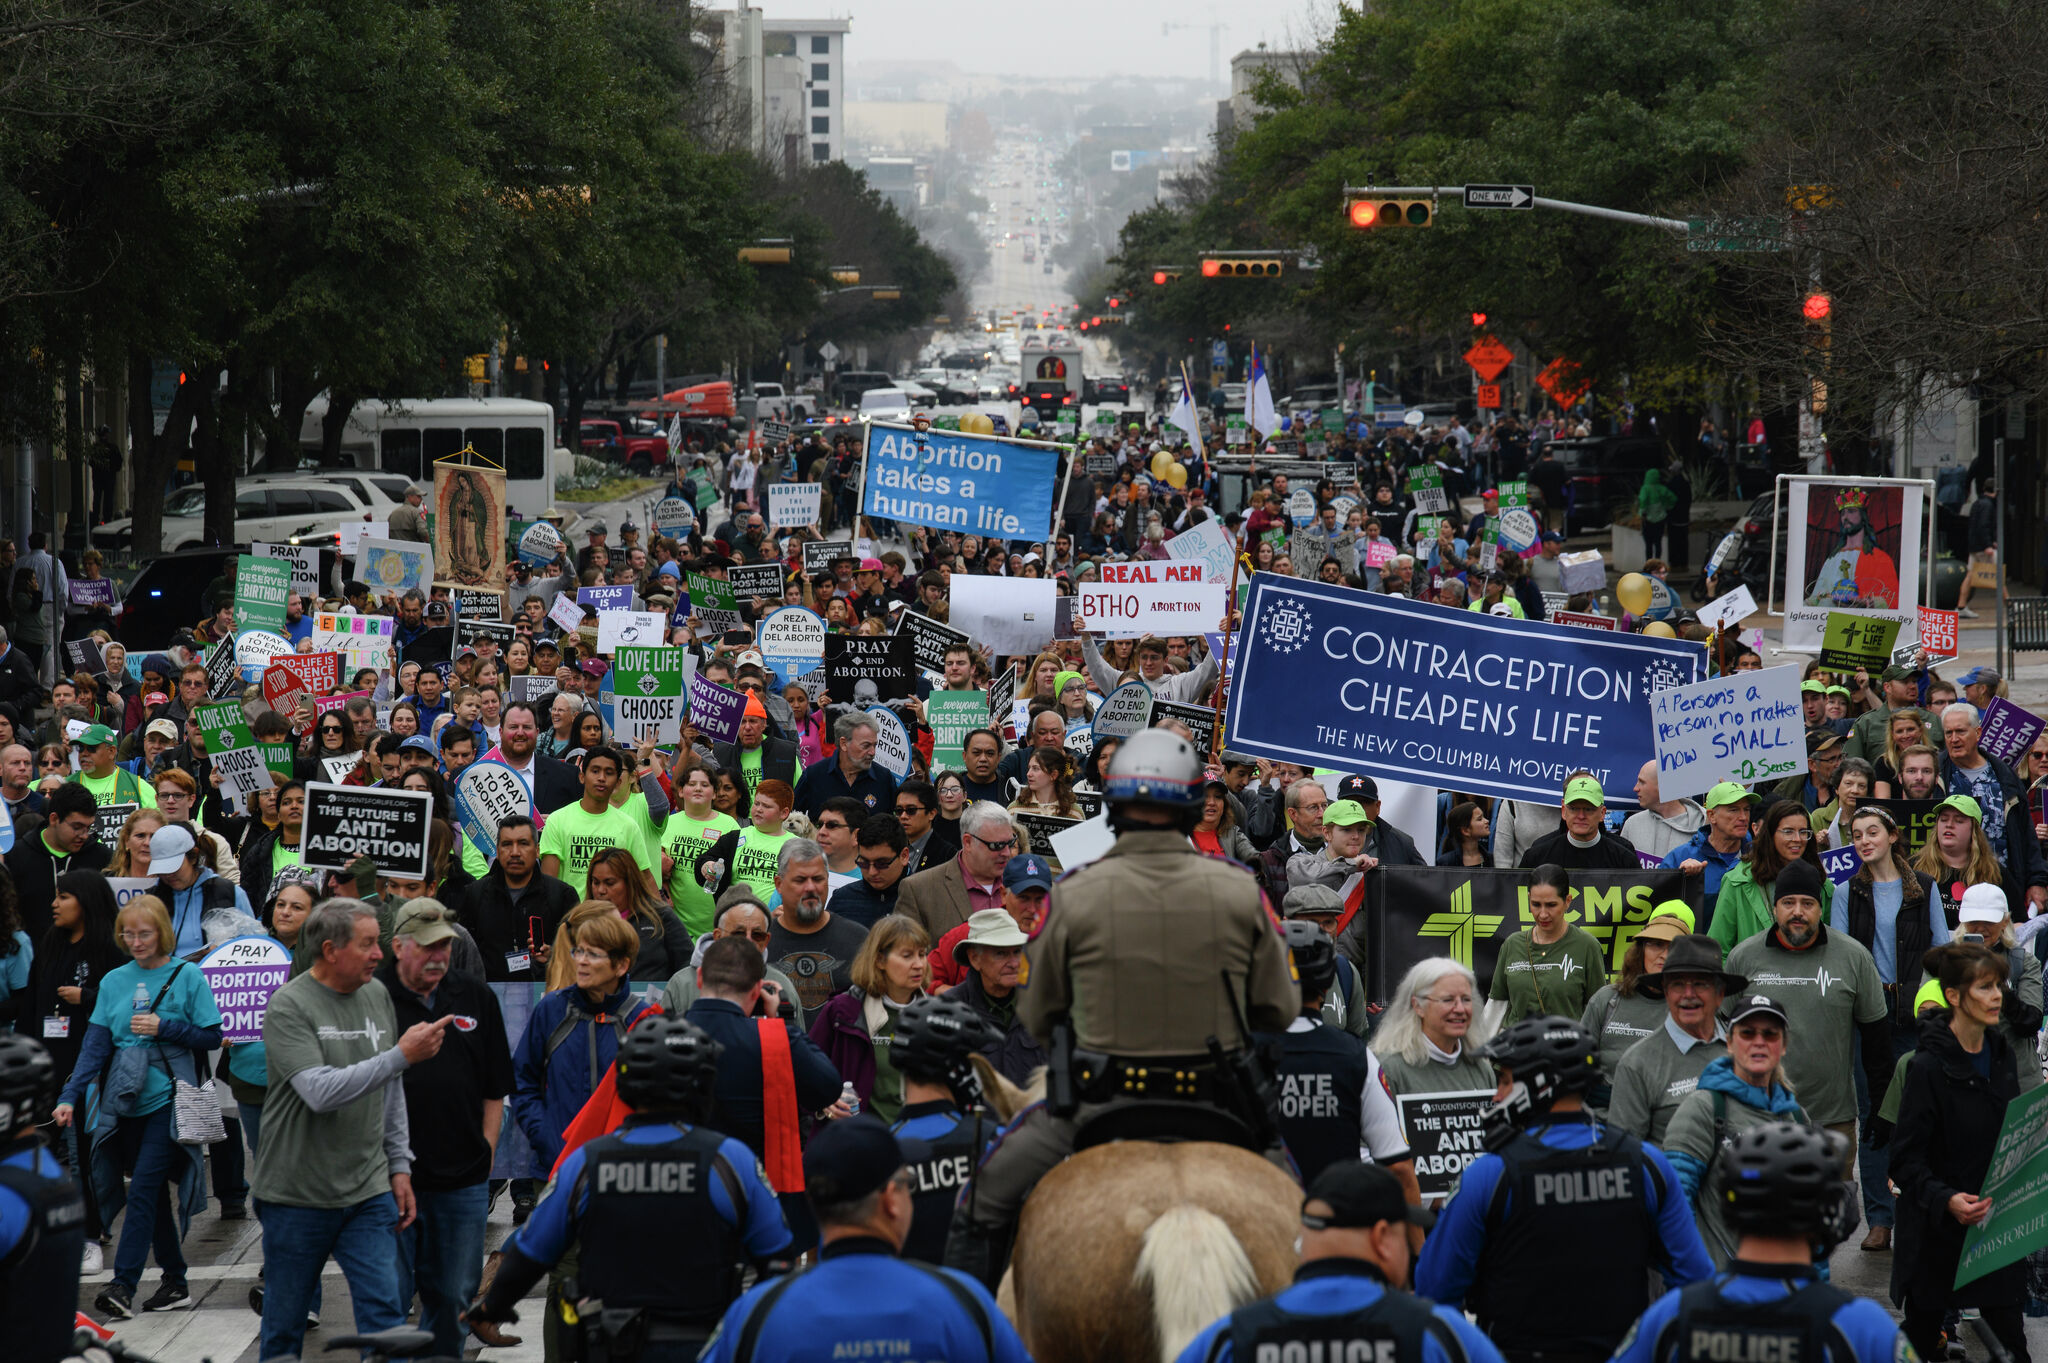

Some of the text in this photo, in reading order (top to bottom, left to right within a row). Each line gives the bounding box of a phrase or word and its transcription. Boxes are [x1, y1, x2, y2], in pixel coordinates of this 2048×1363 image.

[1471, 190, 1513, 202] ONE WAY
[1482, 388, 1496, 399] 15
[879, 435, 1002, 473] Abortion
[1409, 464, 1439, 479] LOVE LIFE
[876, 464, 975, 498] takes a
[771, 486, 819, 495] ADOPTION
[1417, 489, 1442, 500] CHOOSE
[873, 490, 1025, 534] human life.
[1427, 501, 1439, 512] LIFE
[658, 512, 690, 520] ABORTION
[538, 524, 554, 534] PRAY
[543, 534, 557, 543] END
[270, 546, 302, 557] PRAY
[240, 572, 288, 587] DESERVES
[1103, 566, 1202, 583] REAL MEN
[688, 573, 732, 597] LOVE LIFE
[731, 578, 779, 588] POST-ROE
[76, 594, 109, 602] WOMEN
[243, 584, 287, 604] BIRTHDAY
[589, 588, 622, 599] TEXAS
[733, 587, 779, 596] GENERATION
[459, 596, 498, 606] OST-ROE
[600, 598, 609, 607] IS
[1083, 594, 1139, 618] BTHO
[1150, 602, 1201, 612] ABORTION
[696, 607, 735, 622] CHOOSE
[1790, 612, 1818, 622] Iglesia
[1946, 614, 1955, 624] IS
[323, 616, 392, 635] EVERY
[711, 621, 730, 634] LIFE
[770, 624, 788, 632] POR
[1865, 626, 1885, 635] LCMS
[1921, 622, 1954, 635] DENCE
[257, 633, 283, 645] PRAY
[784, 633, 823, 643] ABORTO
[906, 621, 952, 646] THE FUTURE
[1863, 633, 1884, 645] LIFE
[248, 638, 286, 653] TO END
[845, 641, 892, 654] PRAY
[1922, 635, 1954, 650] SED
[322, 655, 333, 665] IS
[618, 650, 680, 672] LOVE LIFE
[1323, 626, 1633, 703] CONTRACEPTION
[210, 661, 237, 698] ABORTIO
[833, 667, 906, 678] ABORTION.
[267, 670, 289, 693] STOP
[1121, 689, 1143, 699] PRAY
[1657, 698, 1667, 714] A
[1746, 686, 1761, 701] a
[622, 699, 674, 720] CHOOSE
[942, 700, 979, 713] everyone
[1114, 700, 1145, 710] TO END
[1720, 712, 1744, 725] no
[1752, 700, 1800, 722] matter
[196, 704, 244, 731] LOVE LIFE
[1101, 712, 1147, 721] ABORTION
[1340, 678, 1602, 748] CHEAPENS LIFE
[875, 712, 897, 731] PRAY
[882, 729, 901, 745] END
[1071, 733, 1092, 745] PRA
[1990, 726, 2015, 757] URTS
[2002, 722, 2036, 766] OMEN
[267, 747, 290, 762] VIDA
[1316, 725, 1348, 747] THE
[1354, 733, 1398, 755] NEW
[1403, 741, 1502, 774] COLUMBIA
[1660, 728, 1793, 772] how SMALL.
[215, 749, 258, 774] CHOOSE
[232, 772, 259, 792] LIFE
[483, 771, 497, 792] TO
[498, 772, 526, 805] PRAY
[317, 805, 416, 823] THE FUTURE IS
[1087, 803, 1095, 812] IS
[335, 820, 396, 838] ANTI-
[307, 835, 420, 859] ABORTION
[572, 836, 615, 846] UNBORN
[674, 836, 712, 850] UNBORN
[742, 848, 777, 861] UNBOR
[232, 945, 272, 957] PRAY
[213, 991, 268, 1008] HURTS
[219, 1010, 265, 1031] OME
[925, 1015, 961, 1030] POLICE
[1543, 1031, 1580, 1040] POLICE
[1277, 1073, 1332, 1097] ATE
[1279, 1095, 1340, 1118] OPER
[1414, 1115, 1480, 1131] THE FUTU
[598, 1162, 696, 1194] POLICE
[1534, 1167, 1633, 1205] POLICE
[833, 1341, 910, 1359] AUSTIN
[1255, 1341, 1396, 1363] POLICE
[1690, 1331, 1800, 1363] POLICE
